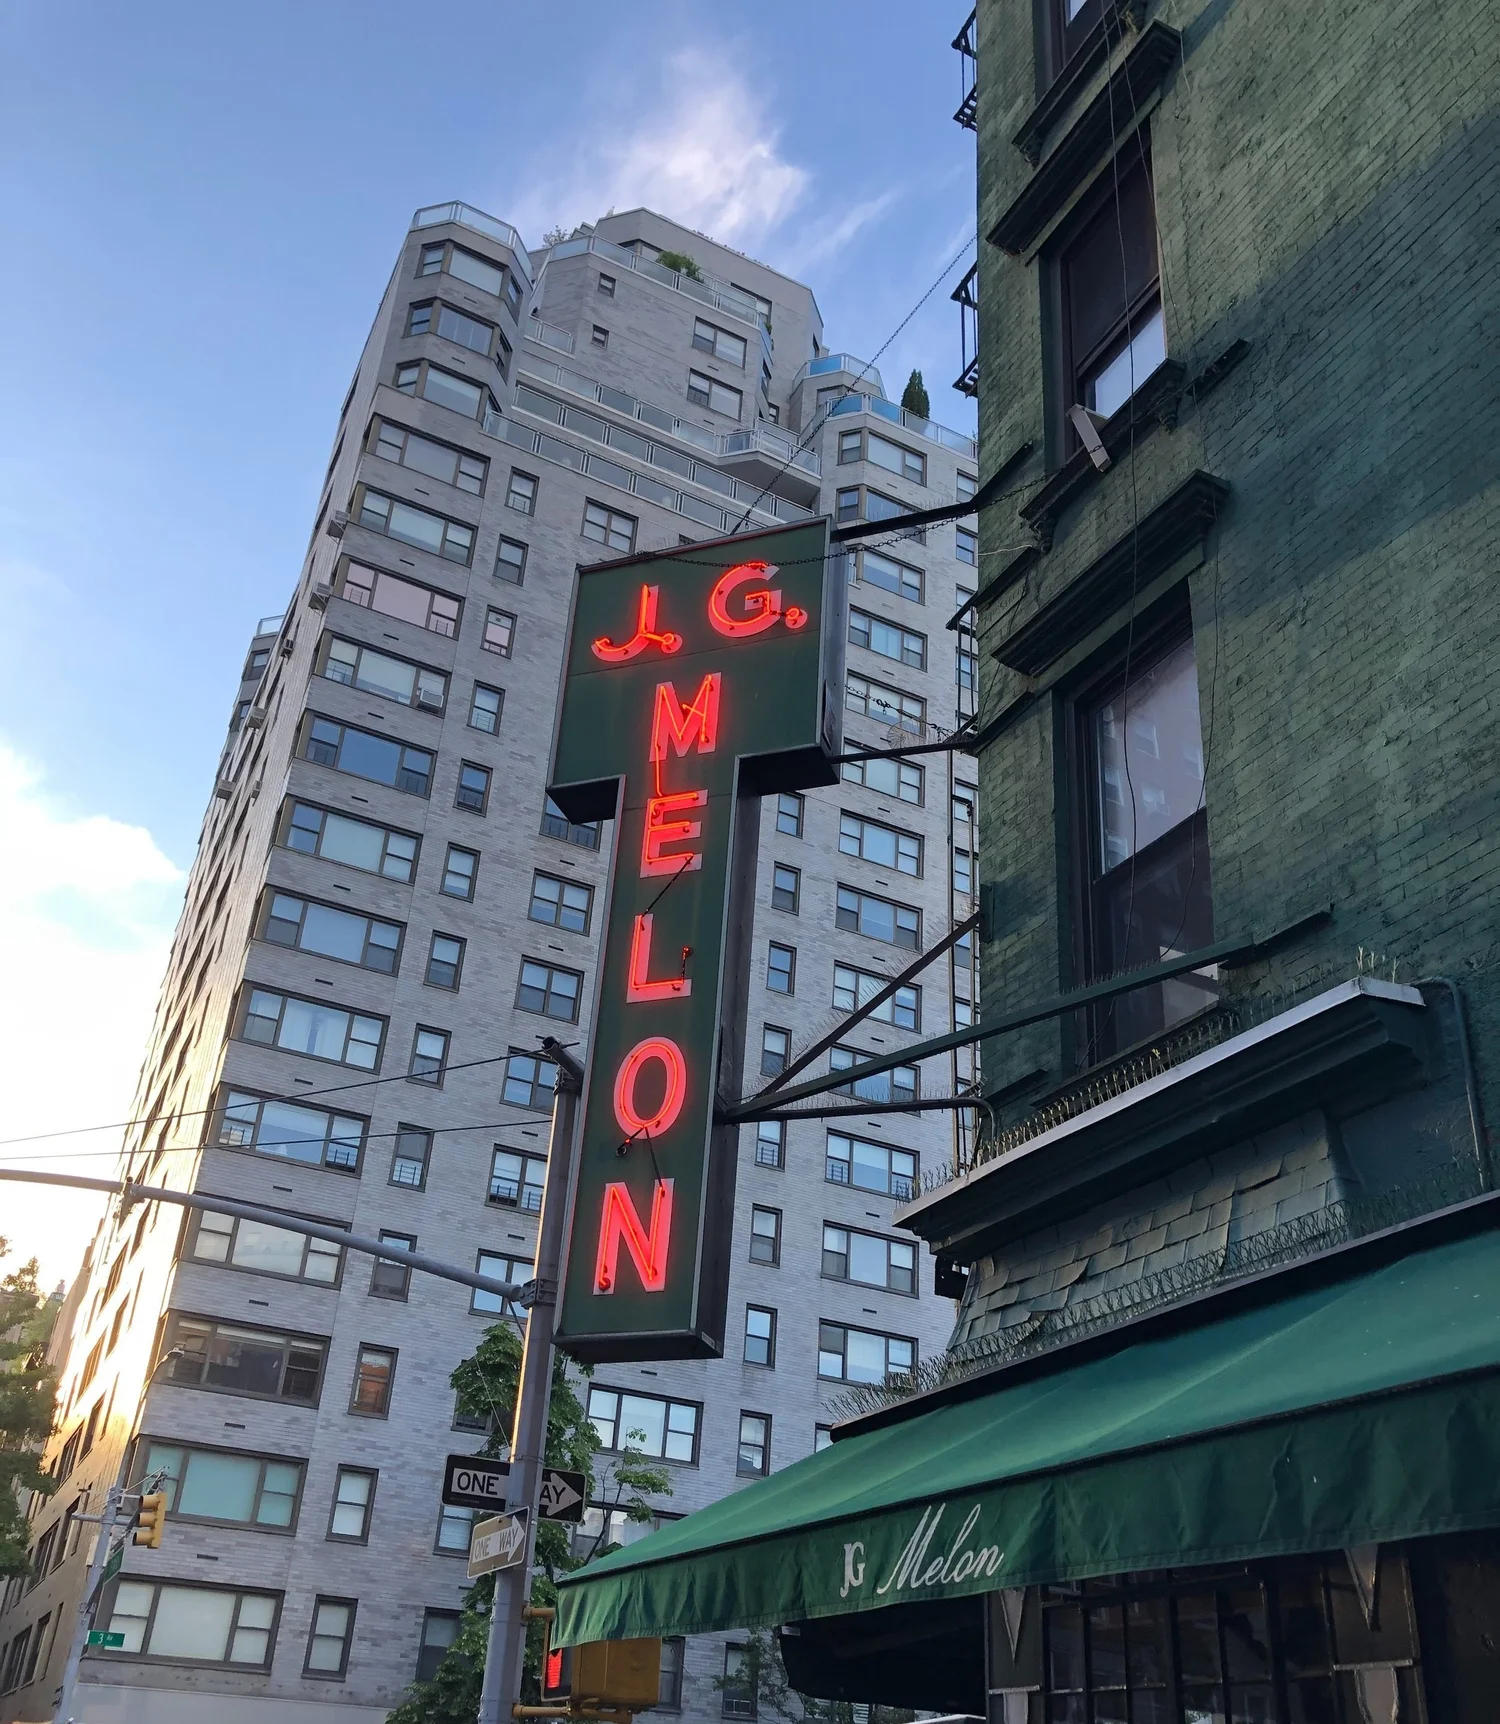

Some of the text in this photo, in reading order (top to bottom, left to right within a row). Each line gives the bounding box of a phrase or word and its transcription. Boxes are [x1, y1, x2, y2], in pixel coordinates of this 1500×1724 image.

[591, 561, 808, 662] J. G.
[592, 671, 722, 1296] MELON
[457, 1471, 566, 1505] ONE AY
[474, 1527, 519, 1559] ONE WAY
[876, 1502, 1004, 1595] Melon
[98, 1633, 104, 1644] 3
